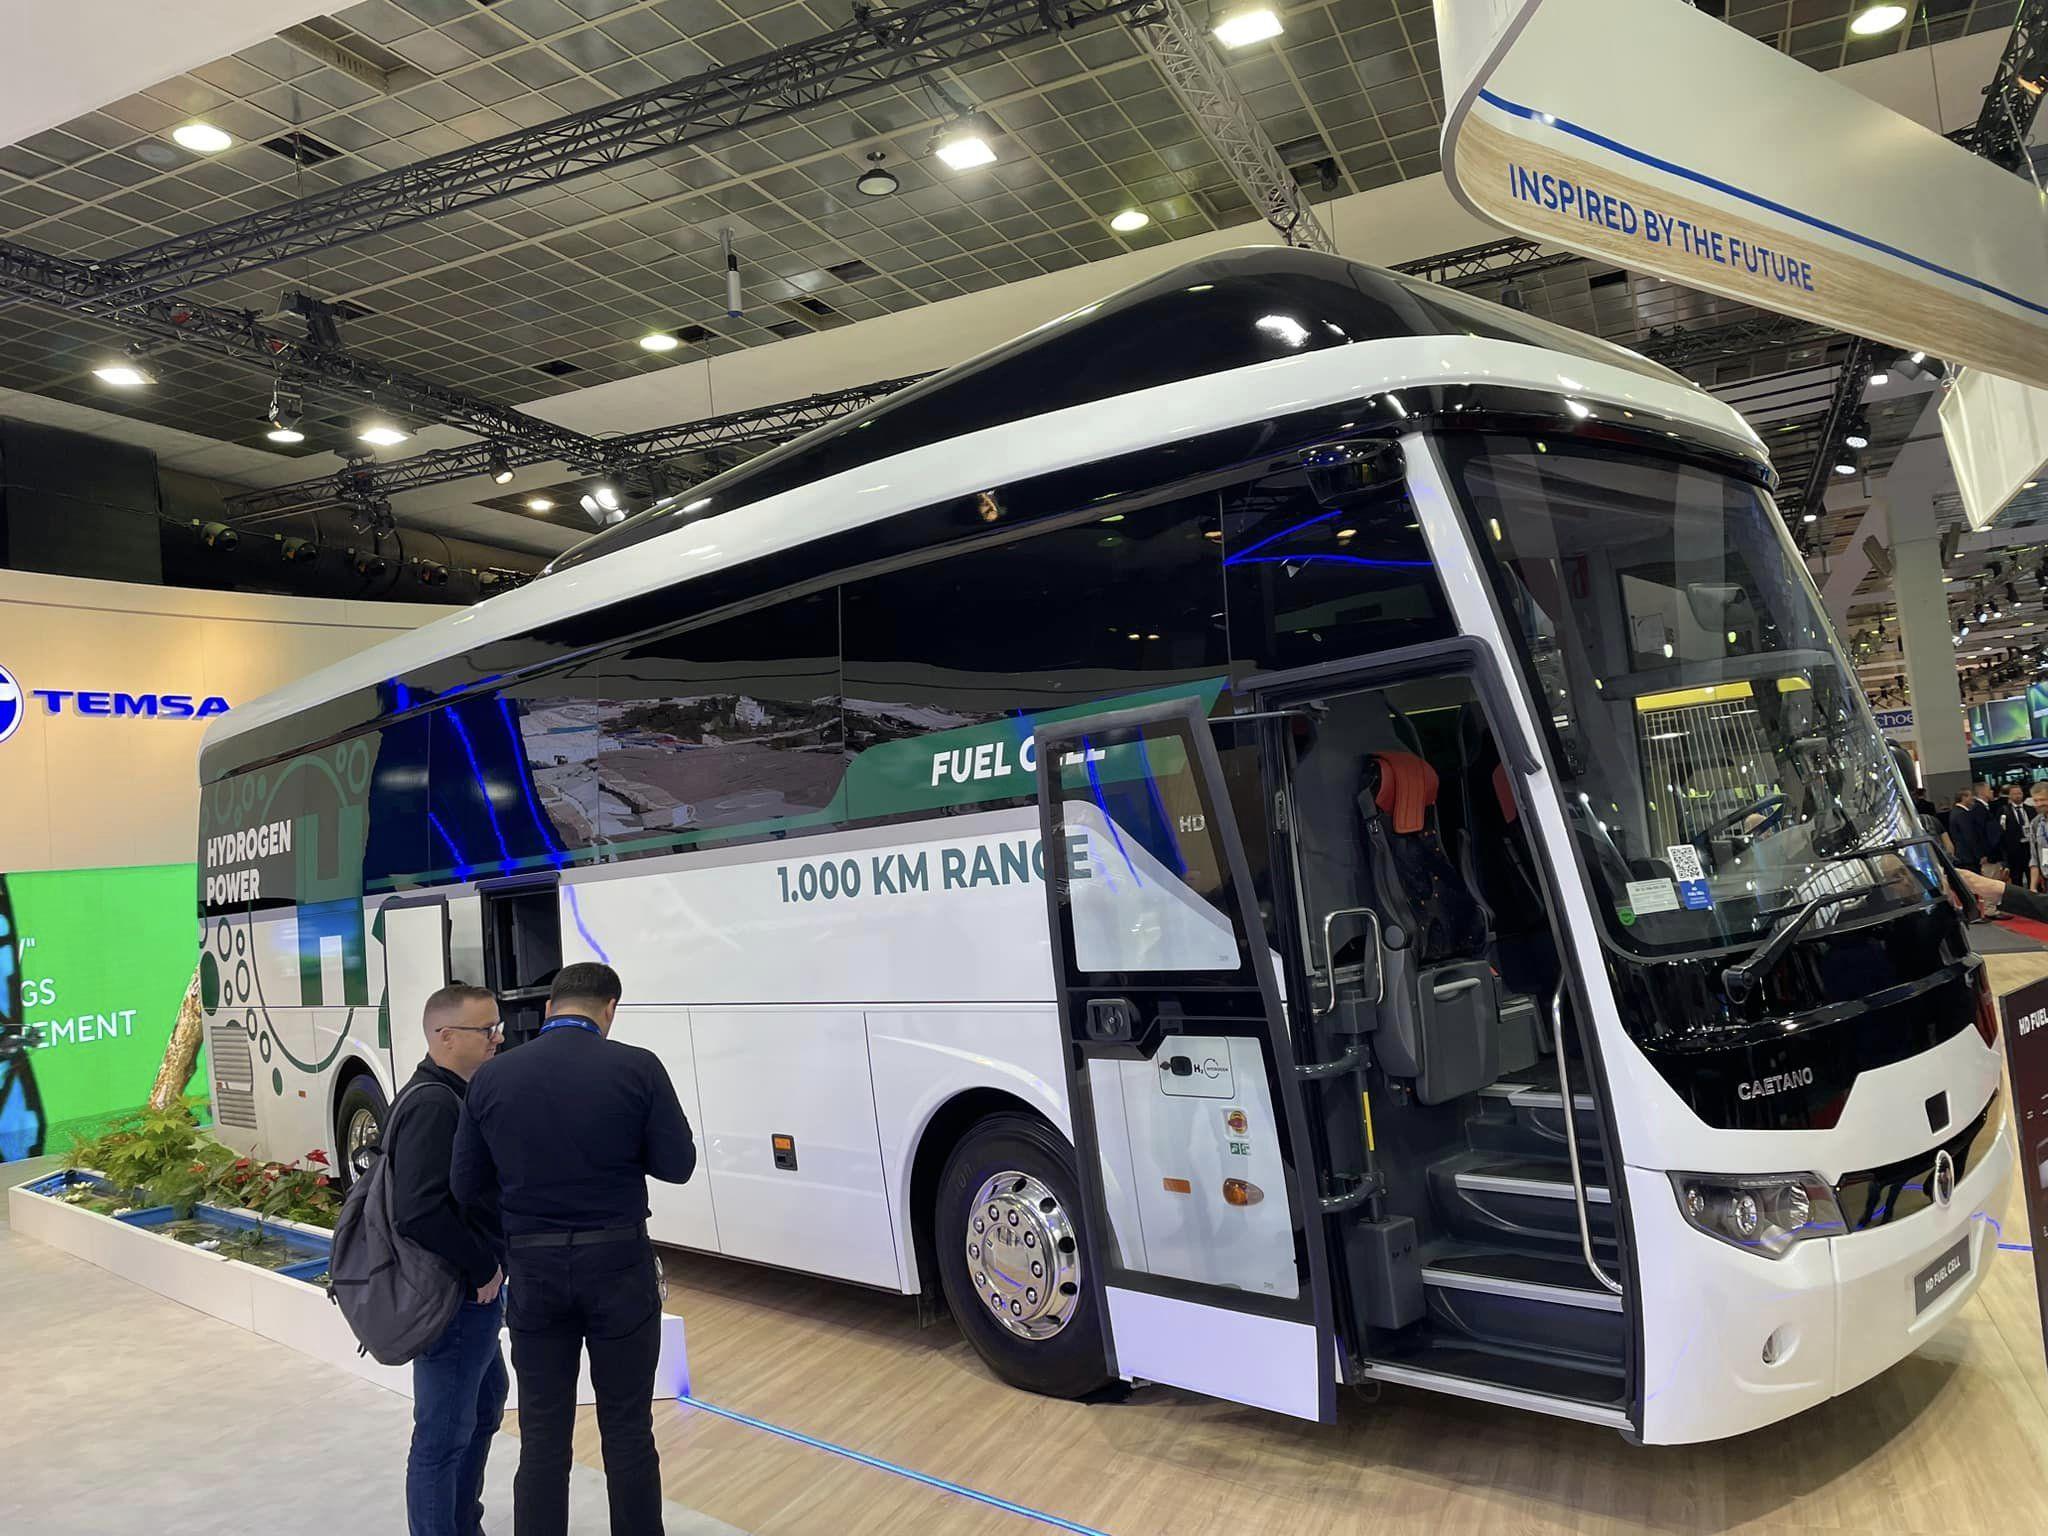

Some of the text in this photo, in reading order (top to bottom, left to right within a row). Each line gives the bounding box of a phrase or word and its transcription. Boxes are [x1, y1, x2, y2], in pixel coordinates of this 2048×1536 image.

[1509, 163, 1815, 291] INSPIRED BY THE FUTURE
[32, 689, 231, 719] TEMSA
[931, 741, 1012, 786] FUEL
[1179, 814, 1206, 832] HD
[207, 819, 292, 868] HYDROGEN
[206, 868, 260, 907] POWER
[777, 858, 861, 903] 1.000
[872, 850, 929, 895] KM
[22, 1009, 137, 1049] EMENT
[1737, 1067, 1814, 1101] CAETANO
